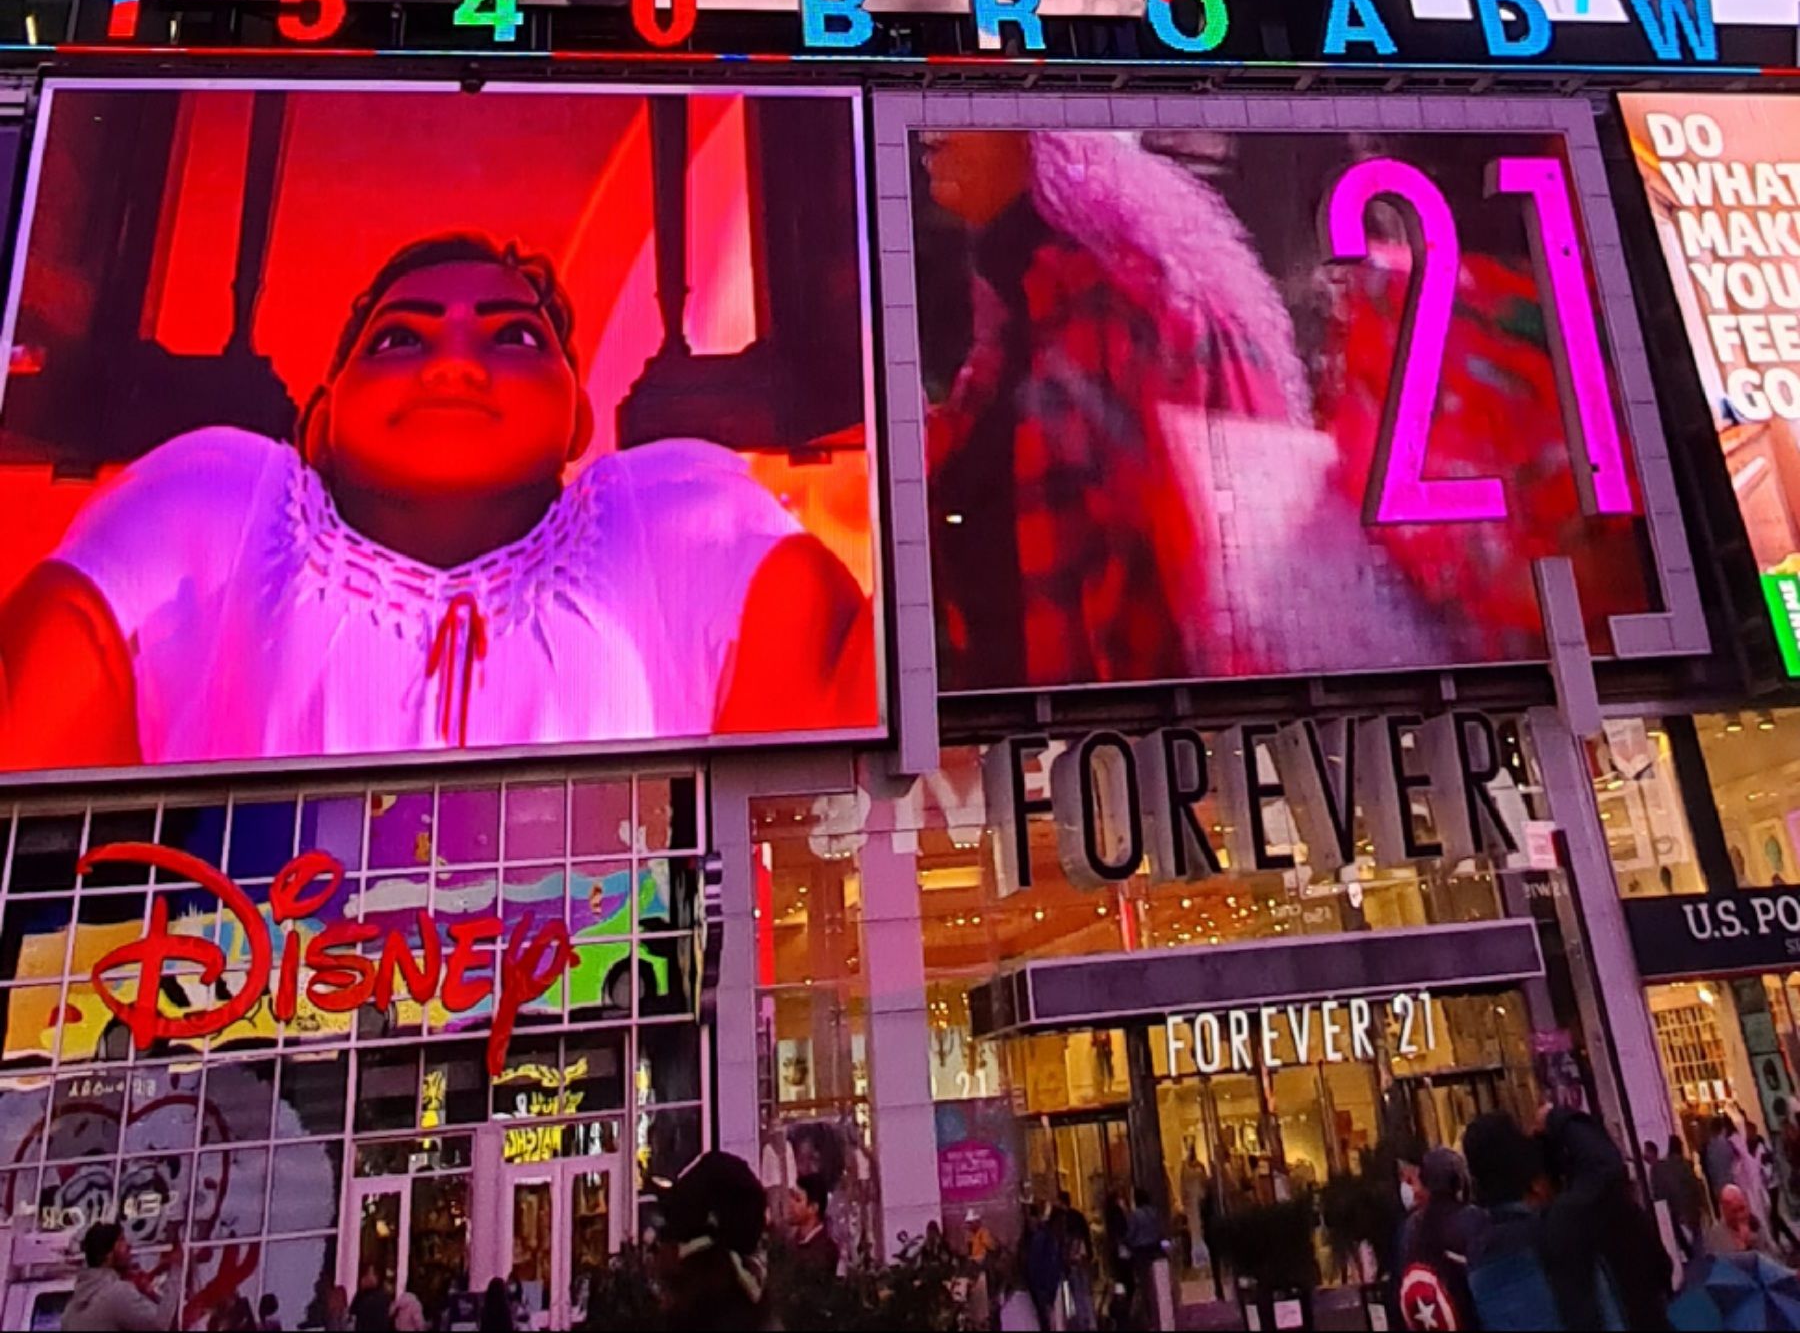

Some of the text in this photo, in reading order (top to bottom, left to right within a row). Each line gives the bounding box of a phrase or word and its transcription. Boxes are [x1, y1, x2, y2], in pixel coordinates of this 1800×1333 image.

[1645, 112, 1724, 158] DO
[1658, 160, 1800, 207] WHAT
[1678, 210, 1800, 258] MAK
[1689, 261, 1800, 309] YOU
[1327, 157, 1633, 523] 21
[1005, 709, 1519, 889] FOREVER
[1681, 899, 1750, 940] U.S.
[1166, 992, 1435, 1077] FOREVER 21
